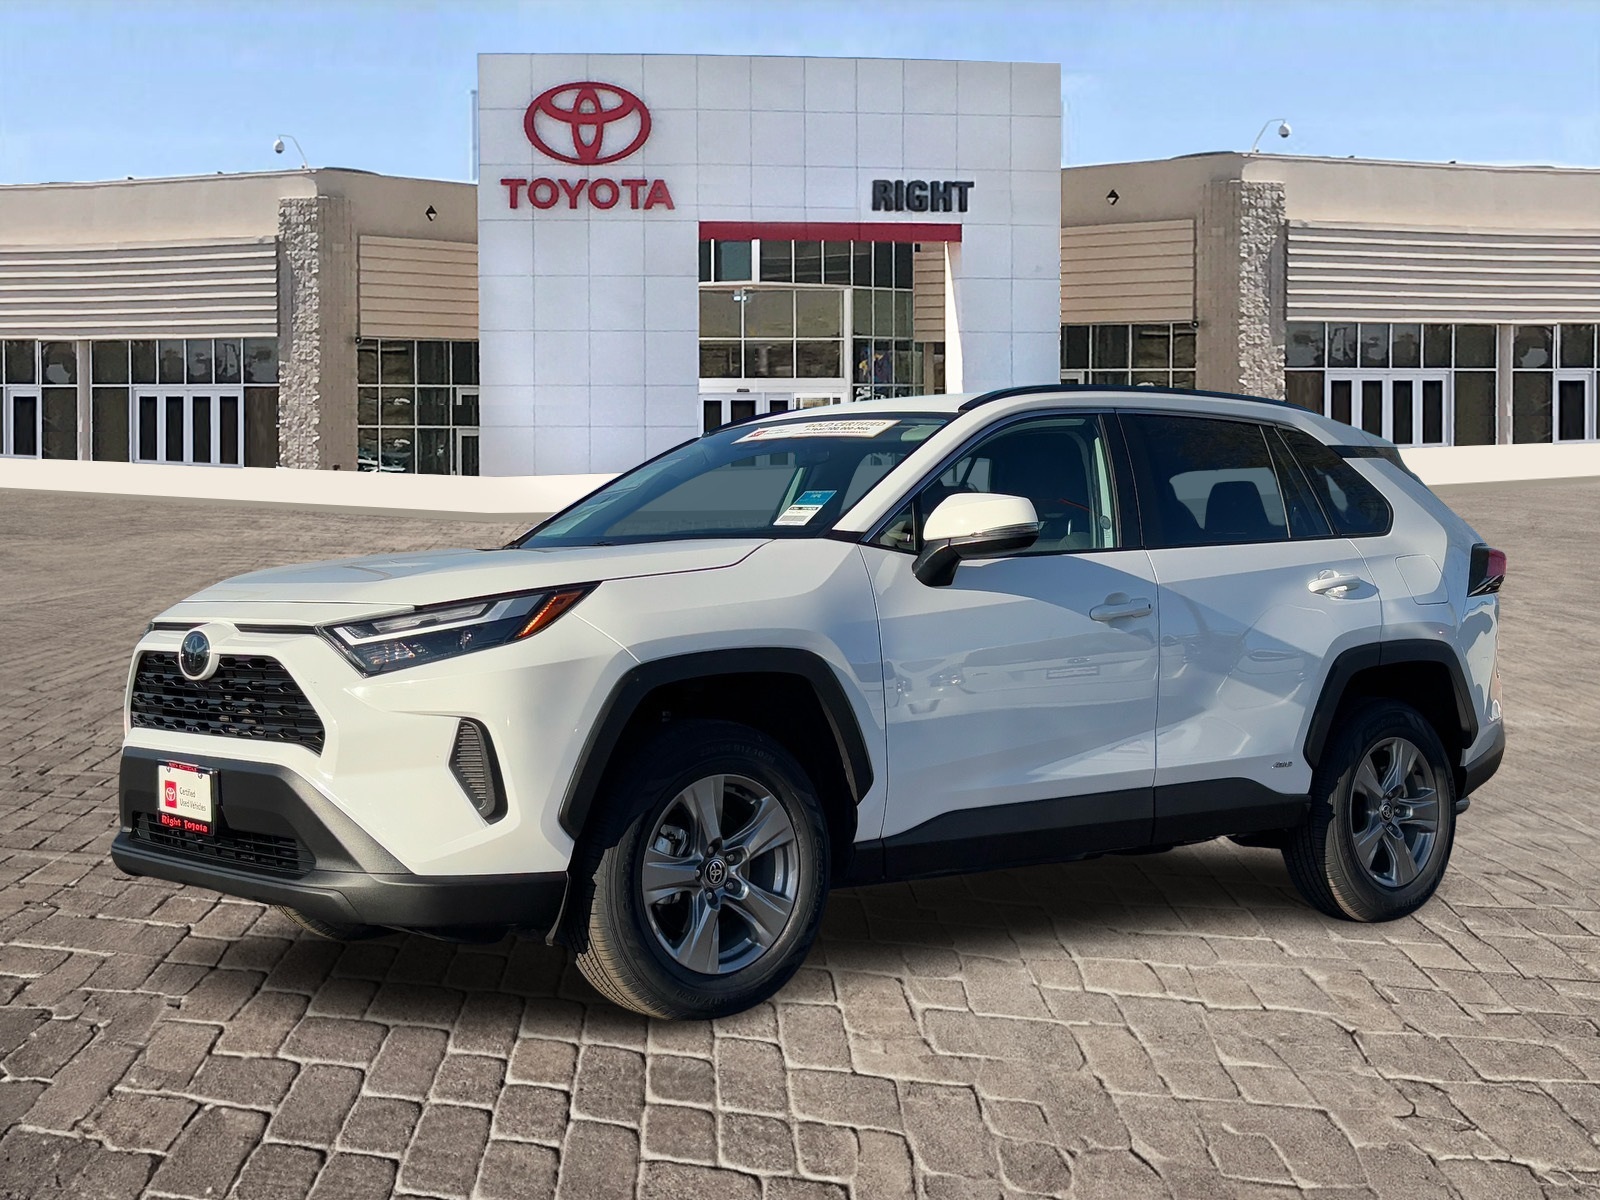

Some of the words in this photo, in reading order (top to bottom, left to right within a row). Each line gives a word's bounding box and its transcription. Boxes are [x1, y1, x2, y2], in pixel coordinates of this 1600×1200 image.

[500, 177, 675, 210] TOYOTA
[872, 179, 975, 212] RIGHT
[179, 786, 196, 798] Certified
[180, 798, 190, 808] Used
[190, 800, 207, 812] Vehicles
[161, 814, 181, 827] Right
[184, 819, 208, 832] Toyota
